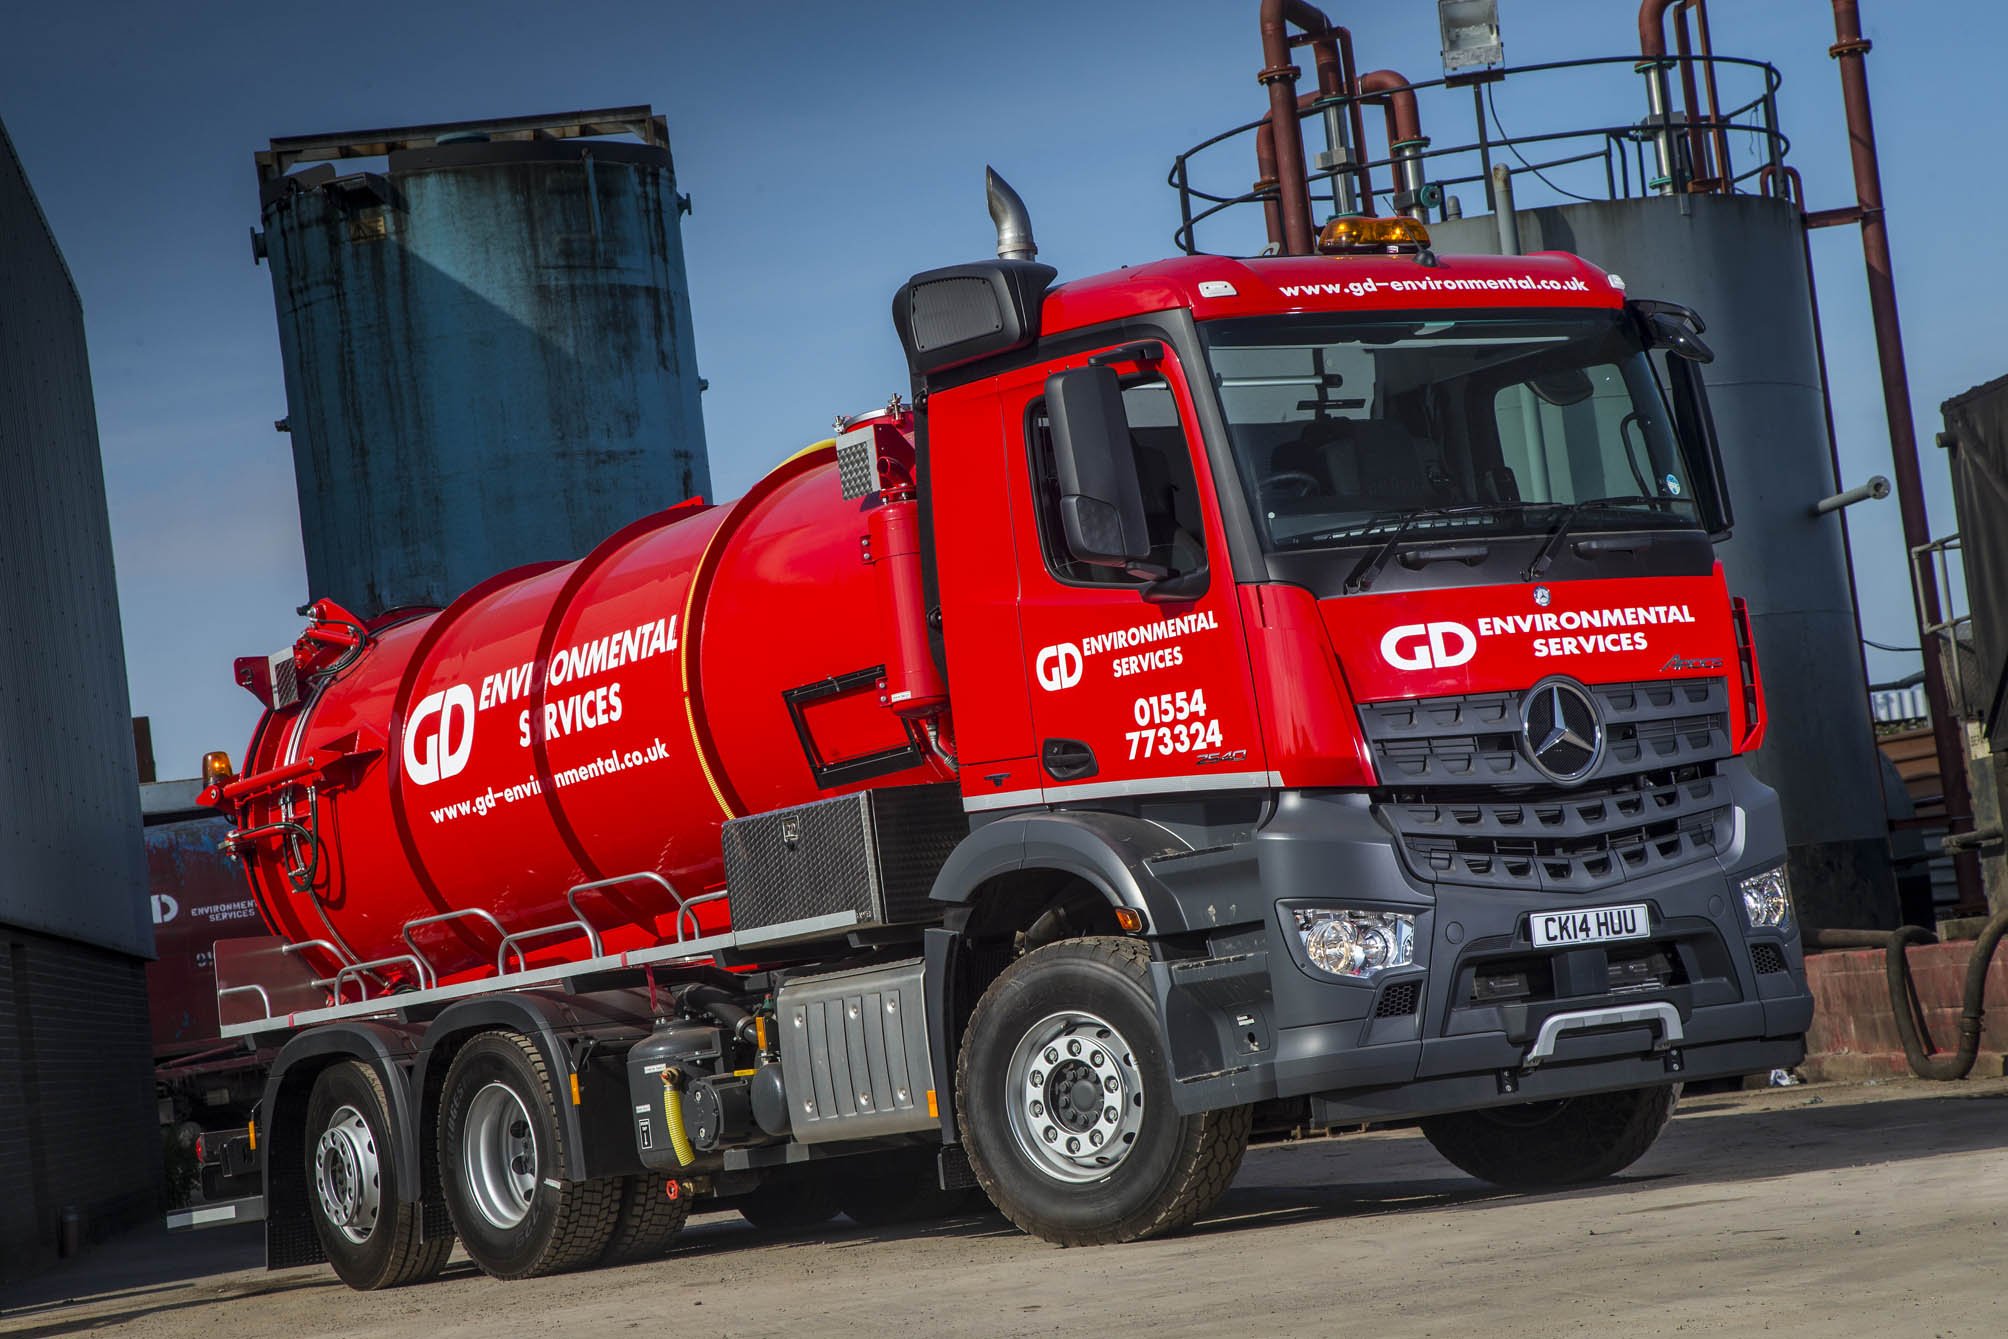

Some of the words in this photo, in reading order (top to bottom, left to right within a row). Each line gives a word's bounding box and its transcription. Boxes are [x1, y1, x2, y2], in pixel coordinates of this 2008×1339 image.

[1278, 275, 1590, 297] www.gd-environmental.co.uk
[1082, 610, 1219, 657] ENVIRONMENTAL
[1477, 604, 1696, 636] ENVIRONMENTAL
[478, 614, 678, 712] ENVIONMENTAL
[1112, 646, 1184, 678] SERVICES
[1380, 621, 1477, 671] GD
[1533, 631, 1648, 657] SERVICES
[1035, 642, 1084, 692] GD
[519, 682, 623, 748] SRVICES
[1134, 688, 1207, 727] 01554
[403, 683, 475, 786] GD
[1125, 719, 1224, 761] 773324
[430, 737, 670, 824] www.gd-envirnmental.co.uk
[191, 900, 257, 917] ENVIRONMEN
[209, 909, 255, 922] SERVICES
[1544, 913, 1591, 942] CK14
[1595, 909, 1637, 937] HUU
